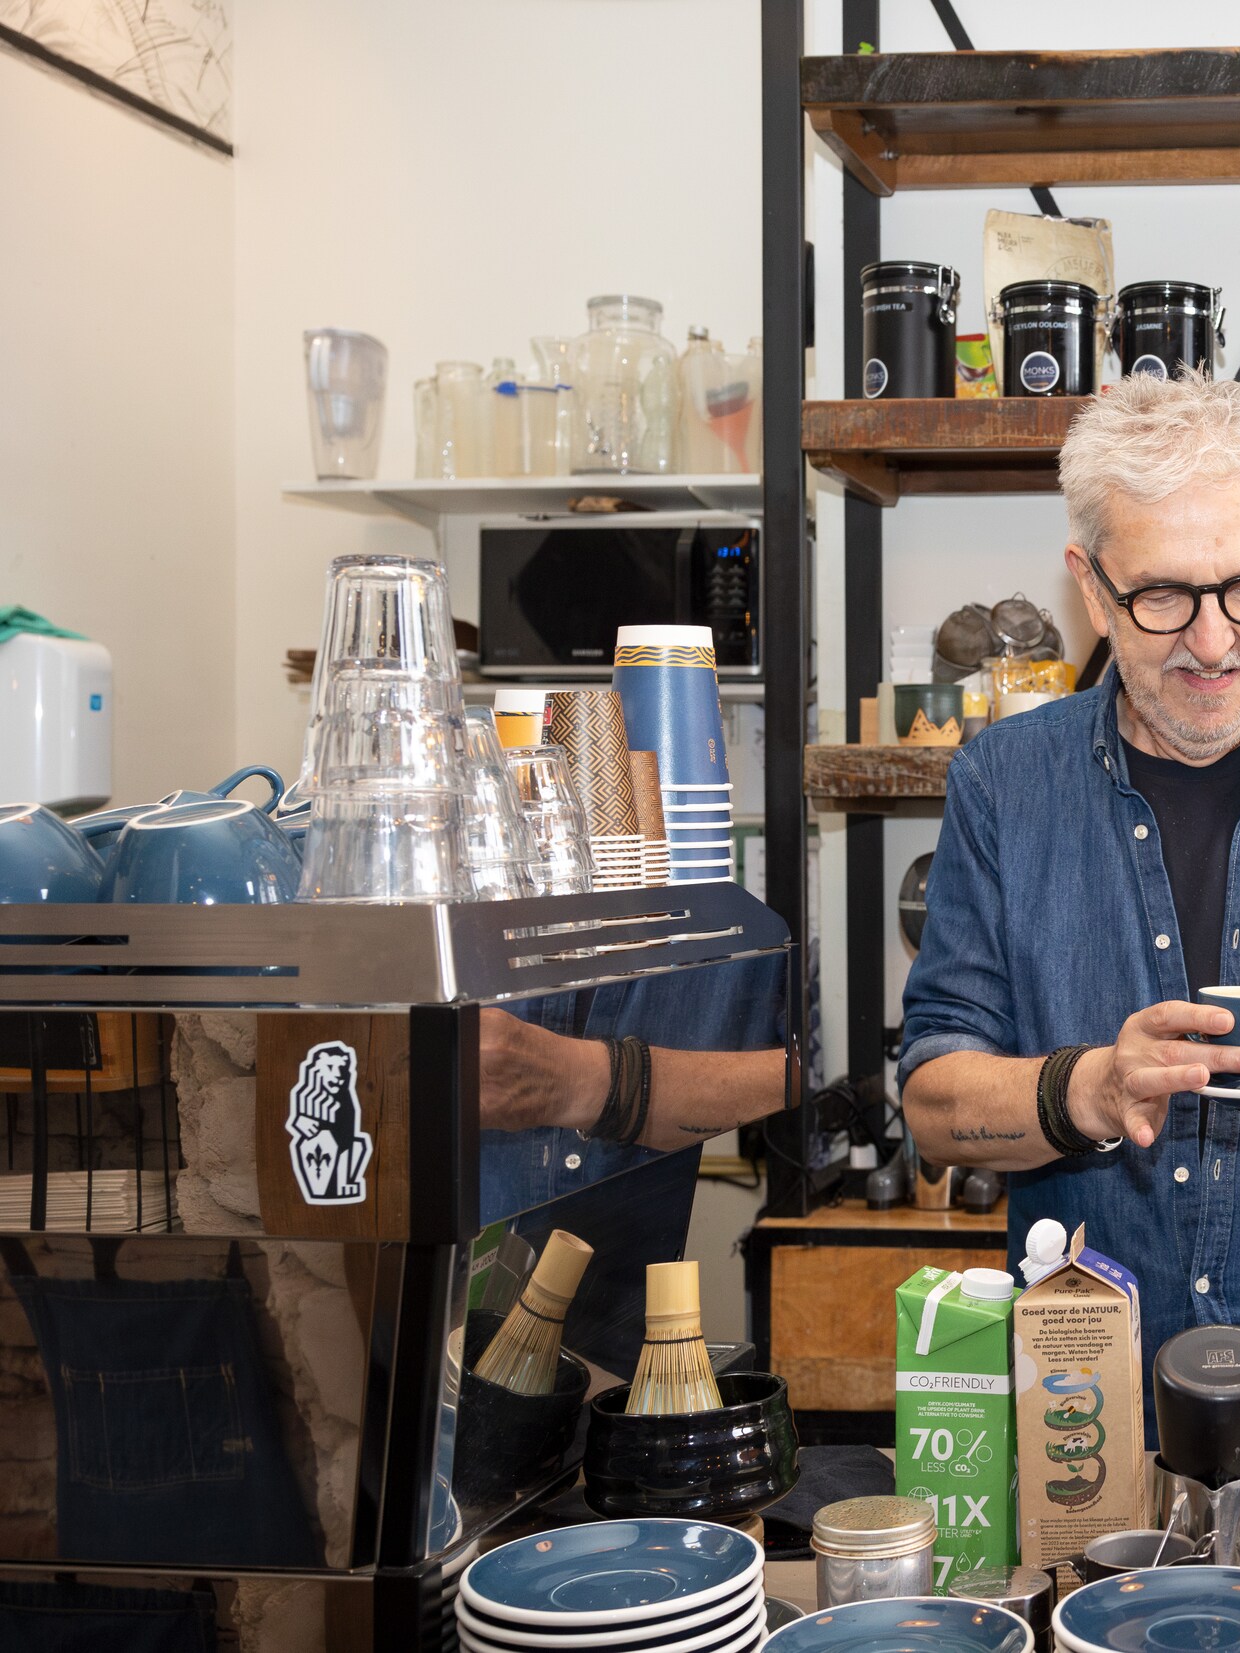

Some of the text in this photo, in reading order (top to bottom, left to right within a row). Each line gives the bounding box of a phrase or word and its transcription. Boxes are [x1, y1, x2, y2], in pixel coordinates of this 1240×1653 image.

[1136, 323, 1163, 331] JASMINE
[1024, 365, 1055, 376] MONKS
[1021, 1308, 1046, 1317] Goed
[1069, 1307, 1080, 1315] de
[1082, 1305, 1122, 1315] NATUUR,
[1042, 1316, 1064, 1326] goed
[1088, 1315, 1102, 1325] jou
[1049, 1328, 1083, 1336] biologische
[909, 1427, 993, 1463] 70%
[920, 1462, 946, 1473] LESS
